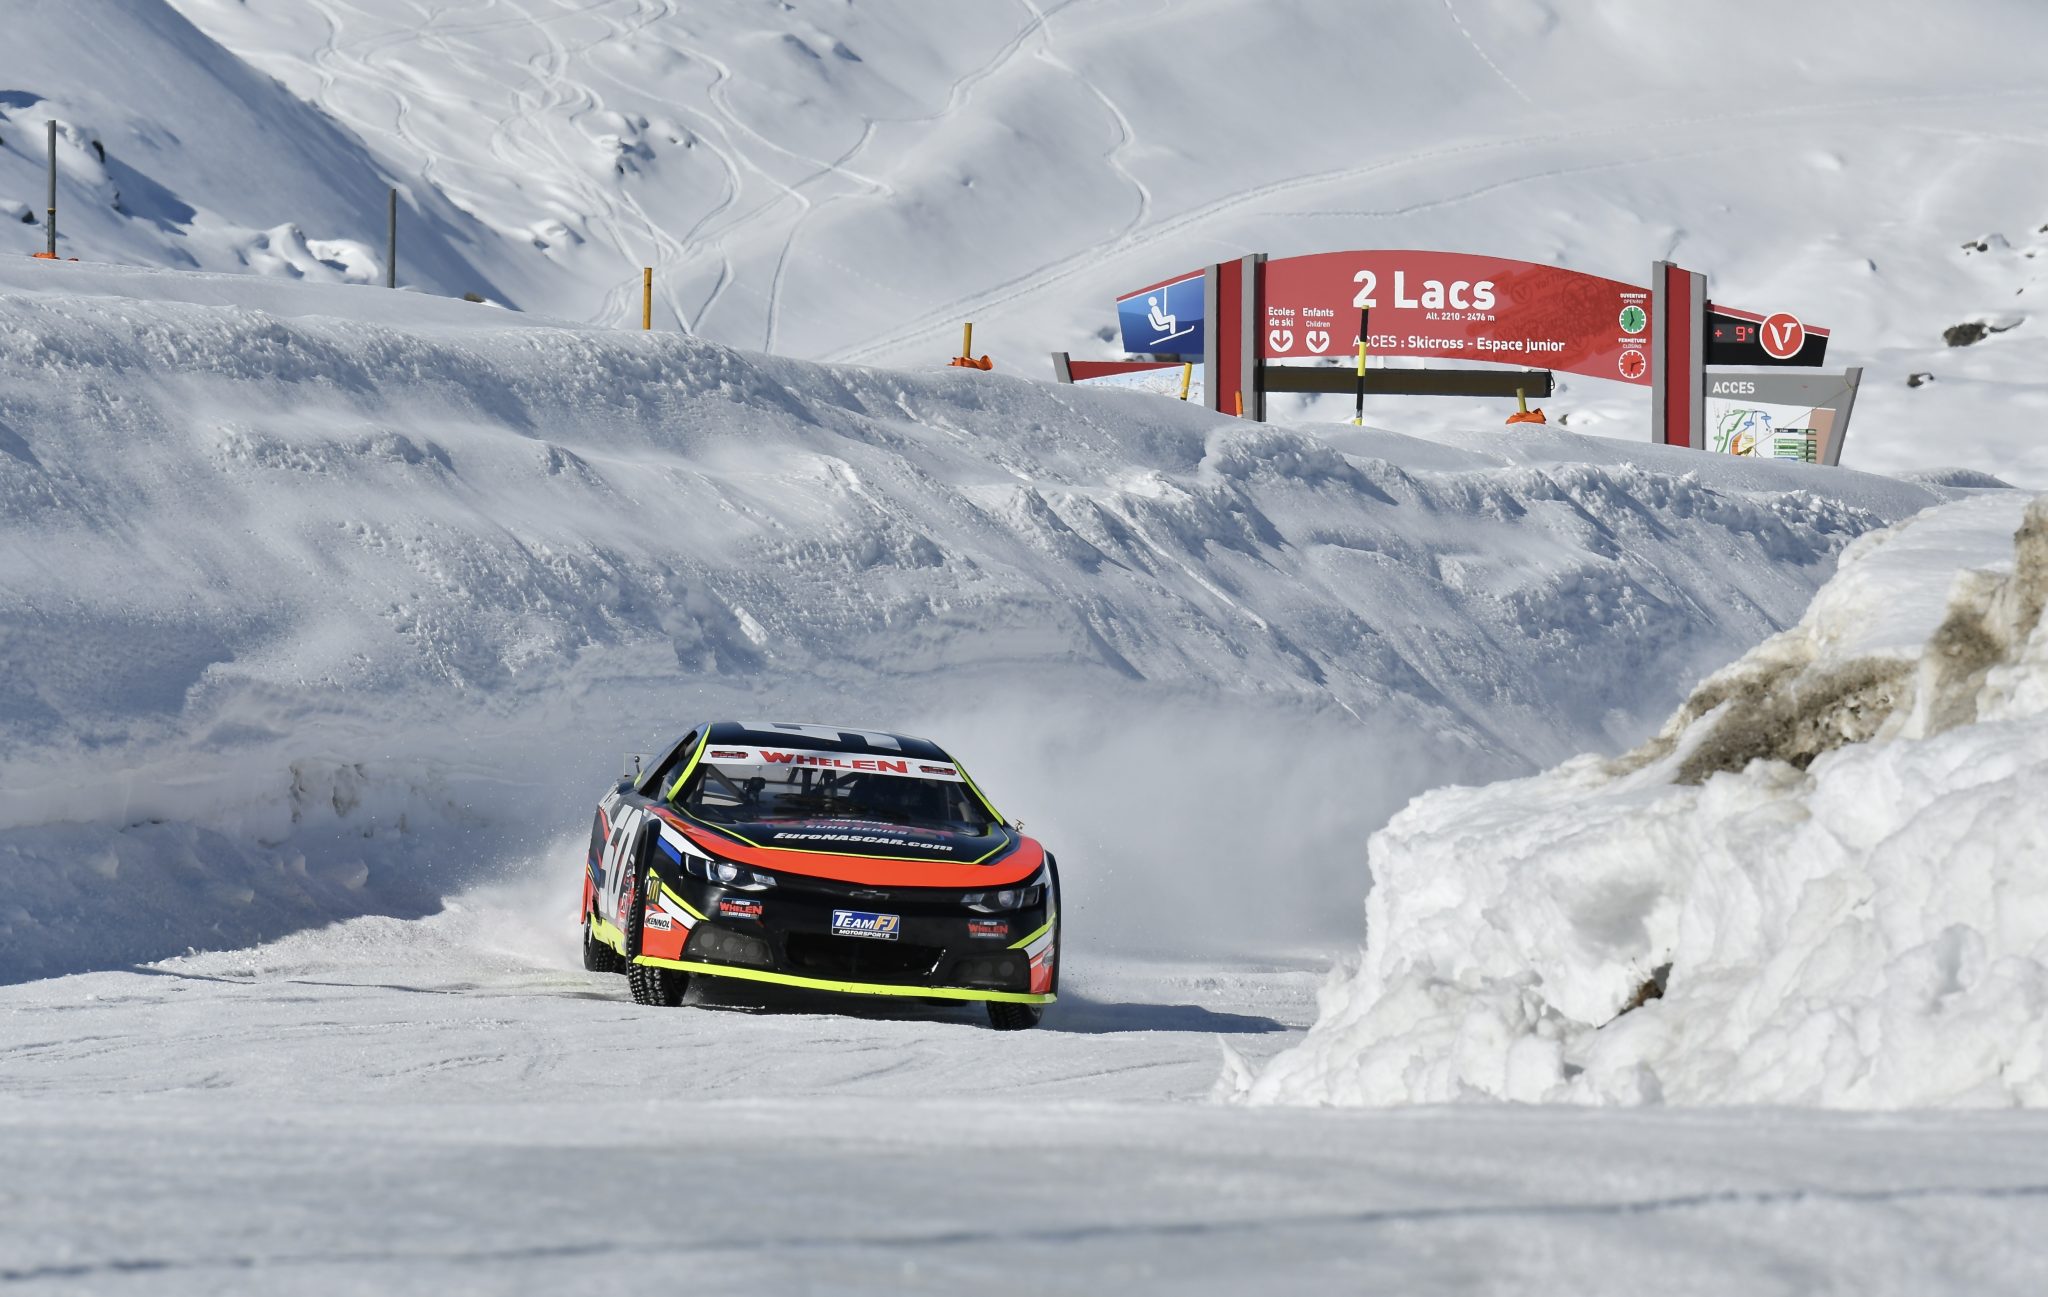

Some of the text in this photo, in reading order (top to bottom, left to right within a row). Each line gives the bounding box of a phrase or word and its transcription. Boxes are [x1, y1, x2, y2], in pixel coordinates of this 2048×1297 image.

[1353, 269, 1377, 308] 2
[1394, 270, 1496, 310] Lacs
[1268, 307, 1295, 316] Ecoles
[1302, 308, 1334, 317] Enfants
[1425, 312, 1440, 321] Alt.
[1441, 312, 1460, 321] 2210
[1467, 313, 1486, 321] 2476
[1269, 318, 1294, 327] de ski
[1408, 335, 1464, 349] Skicross
[1477, 337, 1523, 352] Espace
[1525, 338, 1565, 353] junior
[1712, 381, 1755, 394] ACCES
[759, 750, 909, 774] WHELEN
[773, 832, 953, 851] EuroNASCAR.com
[719, 901, 763, 915] WHELEN
[646, 917, 670, 929] KENNOL
[838, 929, 891, 939] MOTORSPORTS
